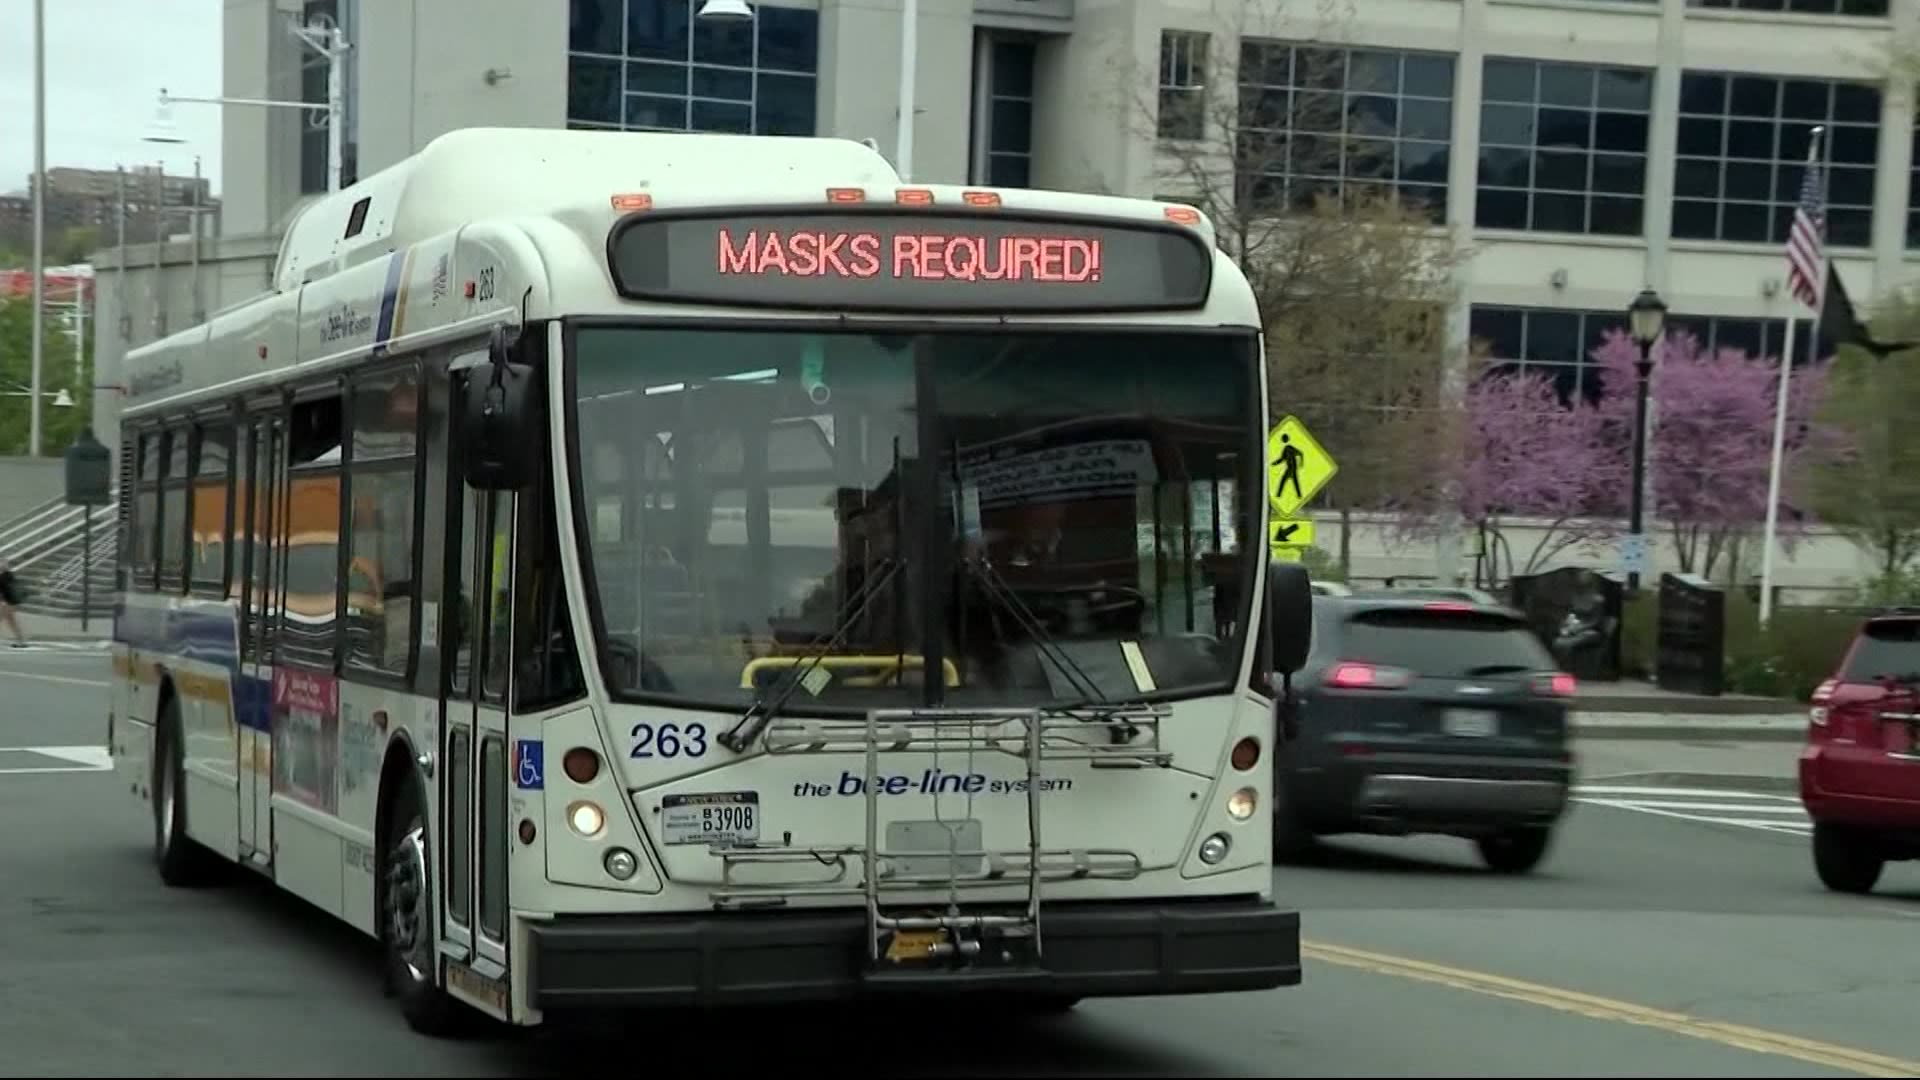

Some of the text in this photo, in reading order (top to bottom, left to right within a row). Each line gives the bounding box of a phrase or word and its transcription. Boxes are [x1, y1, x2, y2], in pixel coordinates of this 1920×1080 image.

[718, 229, 1101, 283] MASKS REQUIRED!
[479, 266, 495, 301] 263
[630, 723, 707, 758] 263
[793, 781, 832, 797] the
[989, 777, 1073, 795] sysem
[714, 806, 753, 831] 3908
